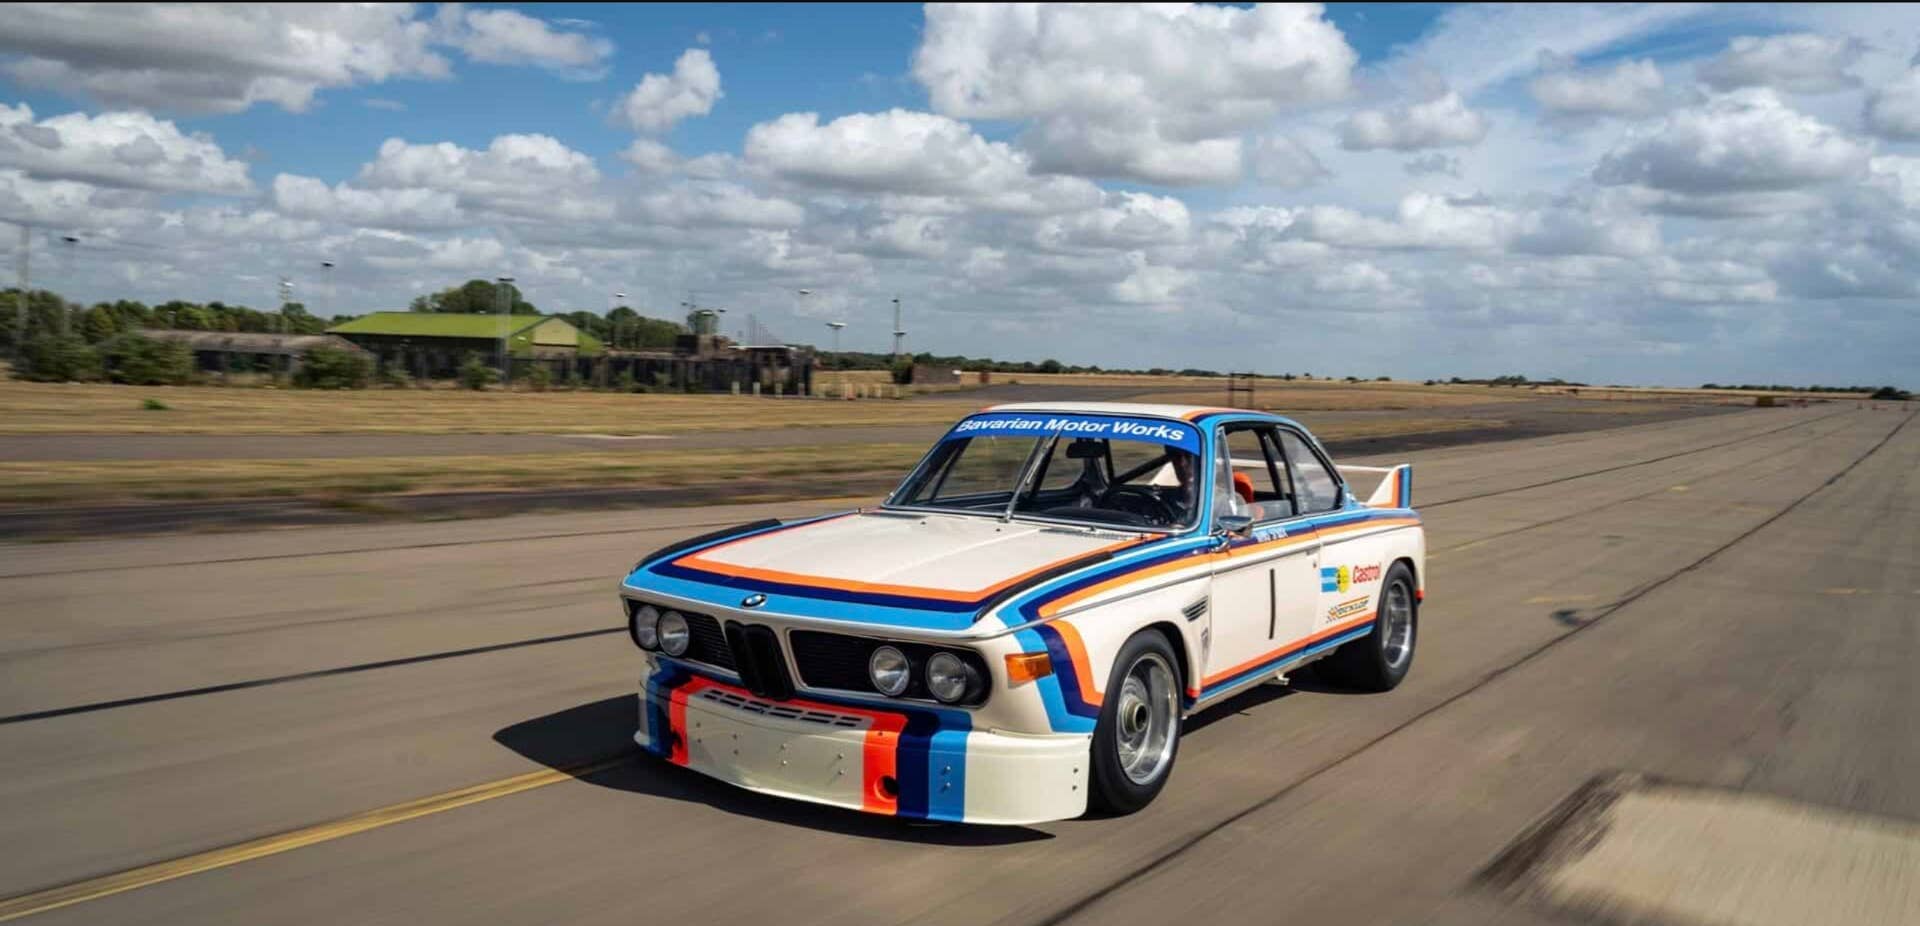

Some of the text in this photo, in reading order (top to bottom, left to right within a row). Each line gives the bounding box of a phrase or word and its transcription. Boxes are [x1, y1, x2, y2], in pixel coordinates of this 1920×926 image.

[955, 417, 1185, 440] Bavarian Motor Works
[1353, 562, 1381, 584] Castrol
[1269, 568, 1276, 640] 1
